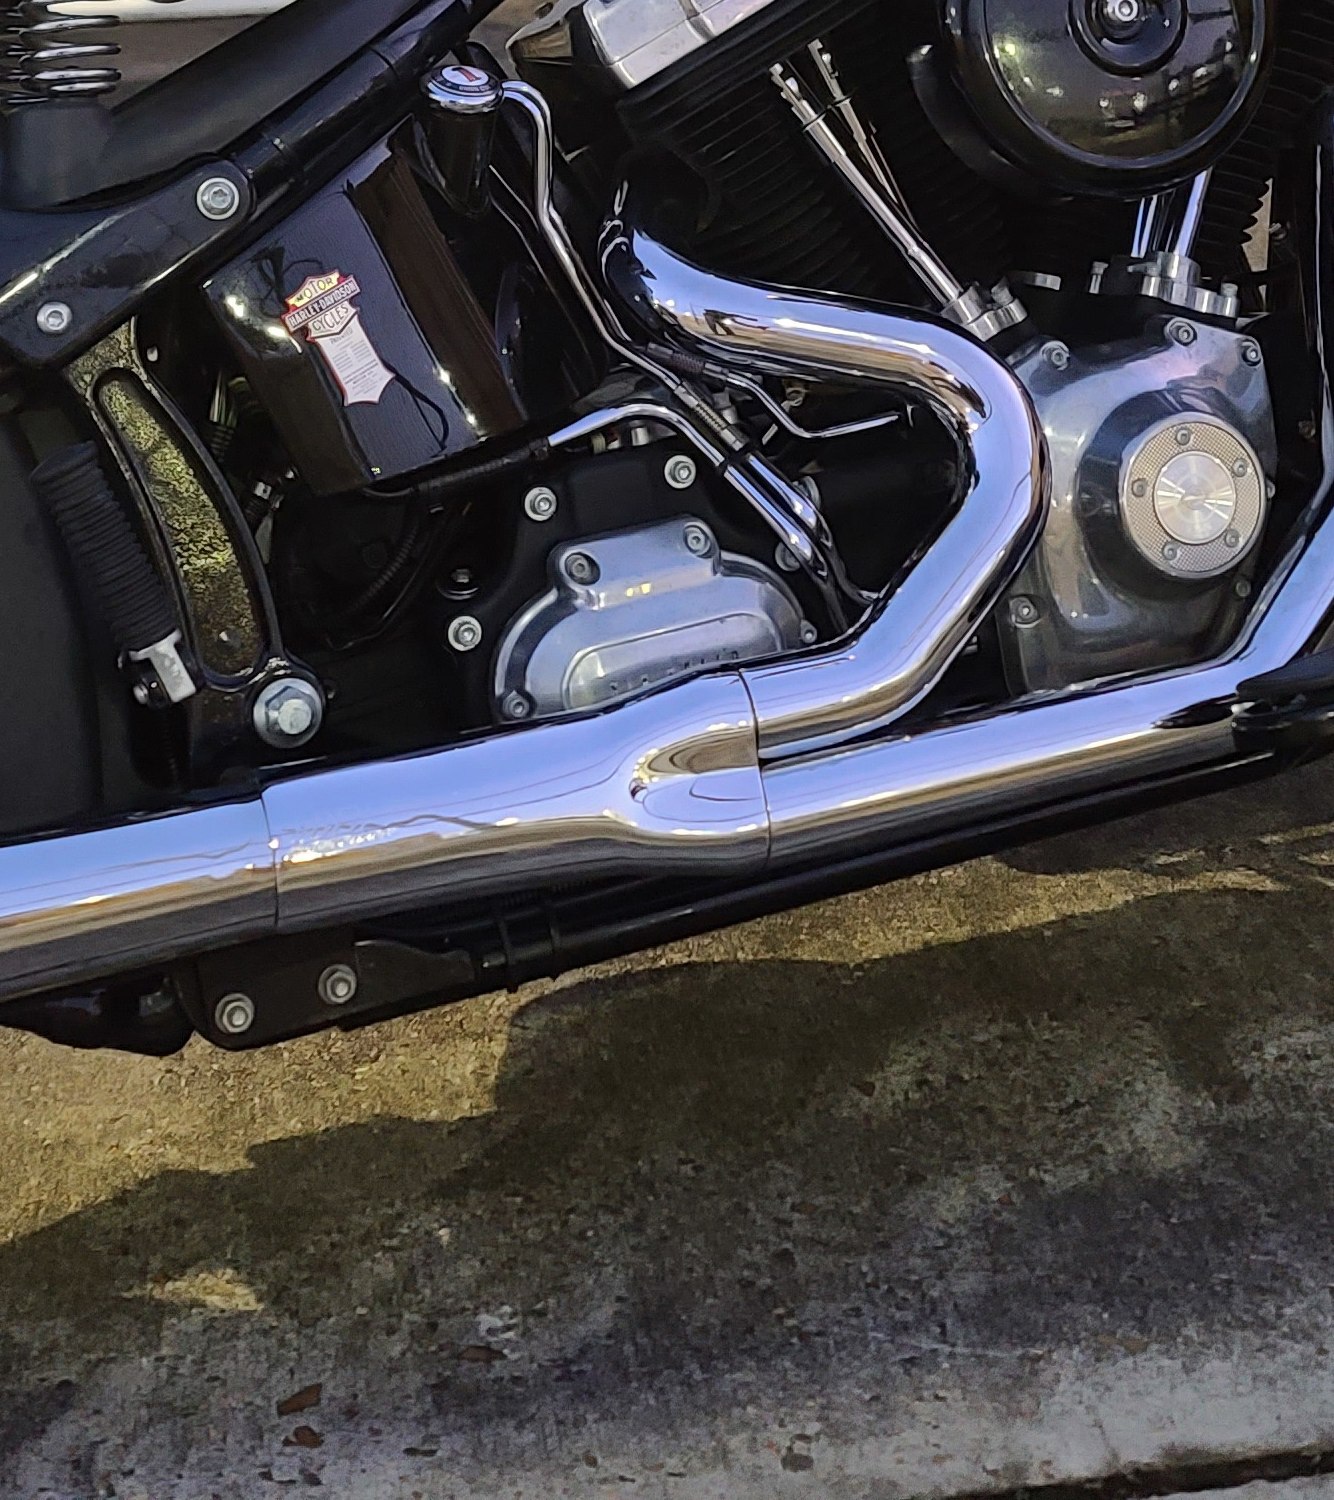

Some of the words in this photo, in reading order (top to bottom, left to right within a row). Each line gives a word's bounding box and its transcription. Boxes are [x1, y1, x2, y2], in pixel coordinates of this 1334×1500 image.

[295, 277, 334, 302] MOTOR
[288, 280, 357, 328] HARLEY-DAVIDSON
[312, 303, 349, 331] CYCLES
